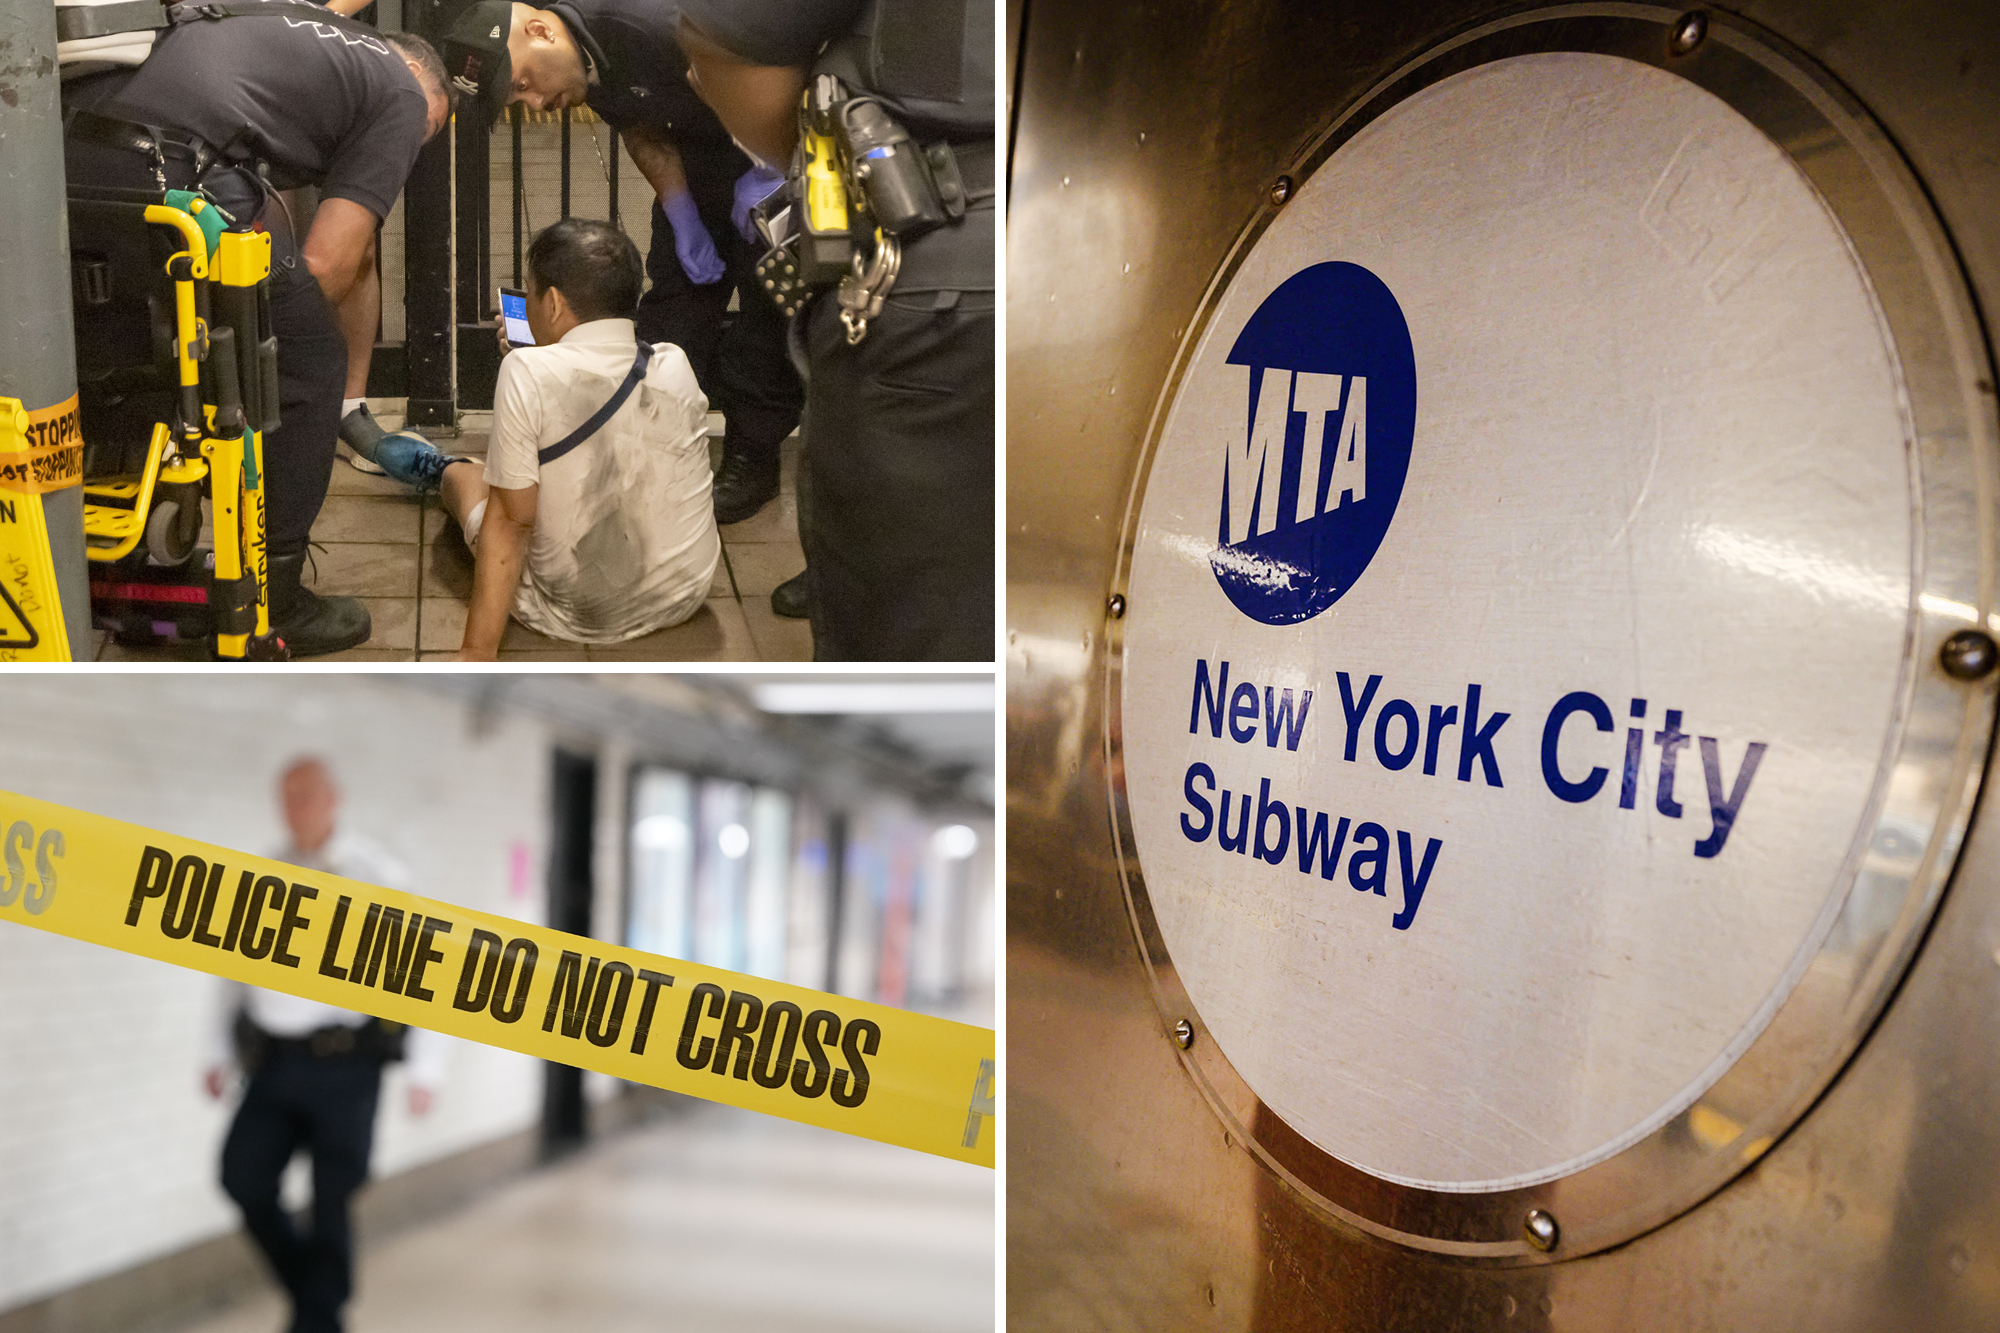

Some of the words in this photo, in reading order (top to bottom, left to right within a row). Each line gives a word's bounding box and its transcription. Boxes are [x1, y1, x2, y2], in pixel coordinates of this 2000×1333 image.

[0, 464, 29, 483] OT
[1207, 363, 1367, 553] MTA
[1179, 762, 1444, 932] Subway
[1189, 658, 1314, 752] New
[1335, 671, 1512, 789] York
[1540, 690, 1769, 859] City
[124, 845, 320, 969] POLICE
[318, 894, 454, 1004] LINE
[451, 928, 540, 1024] DO
[541, 949, 676, 1056] NOT
[675, 982, 881, 1109] CROSS
